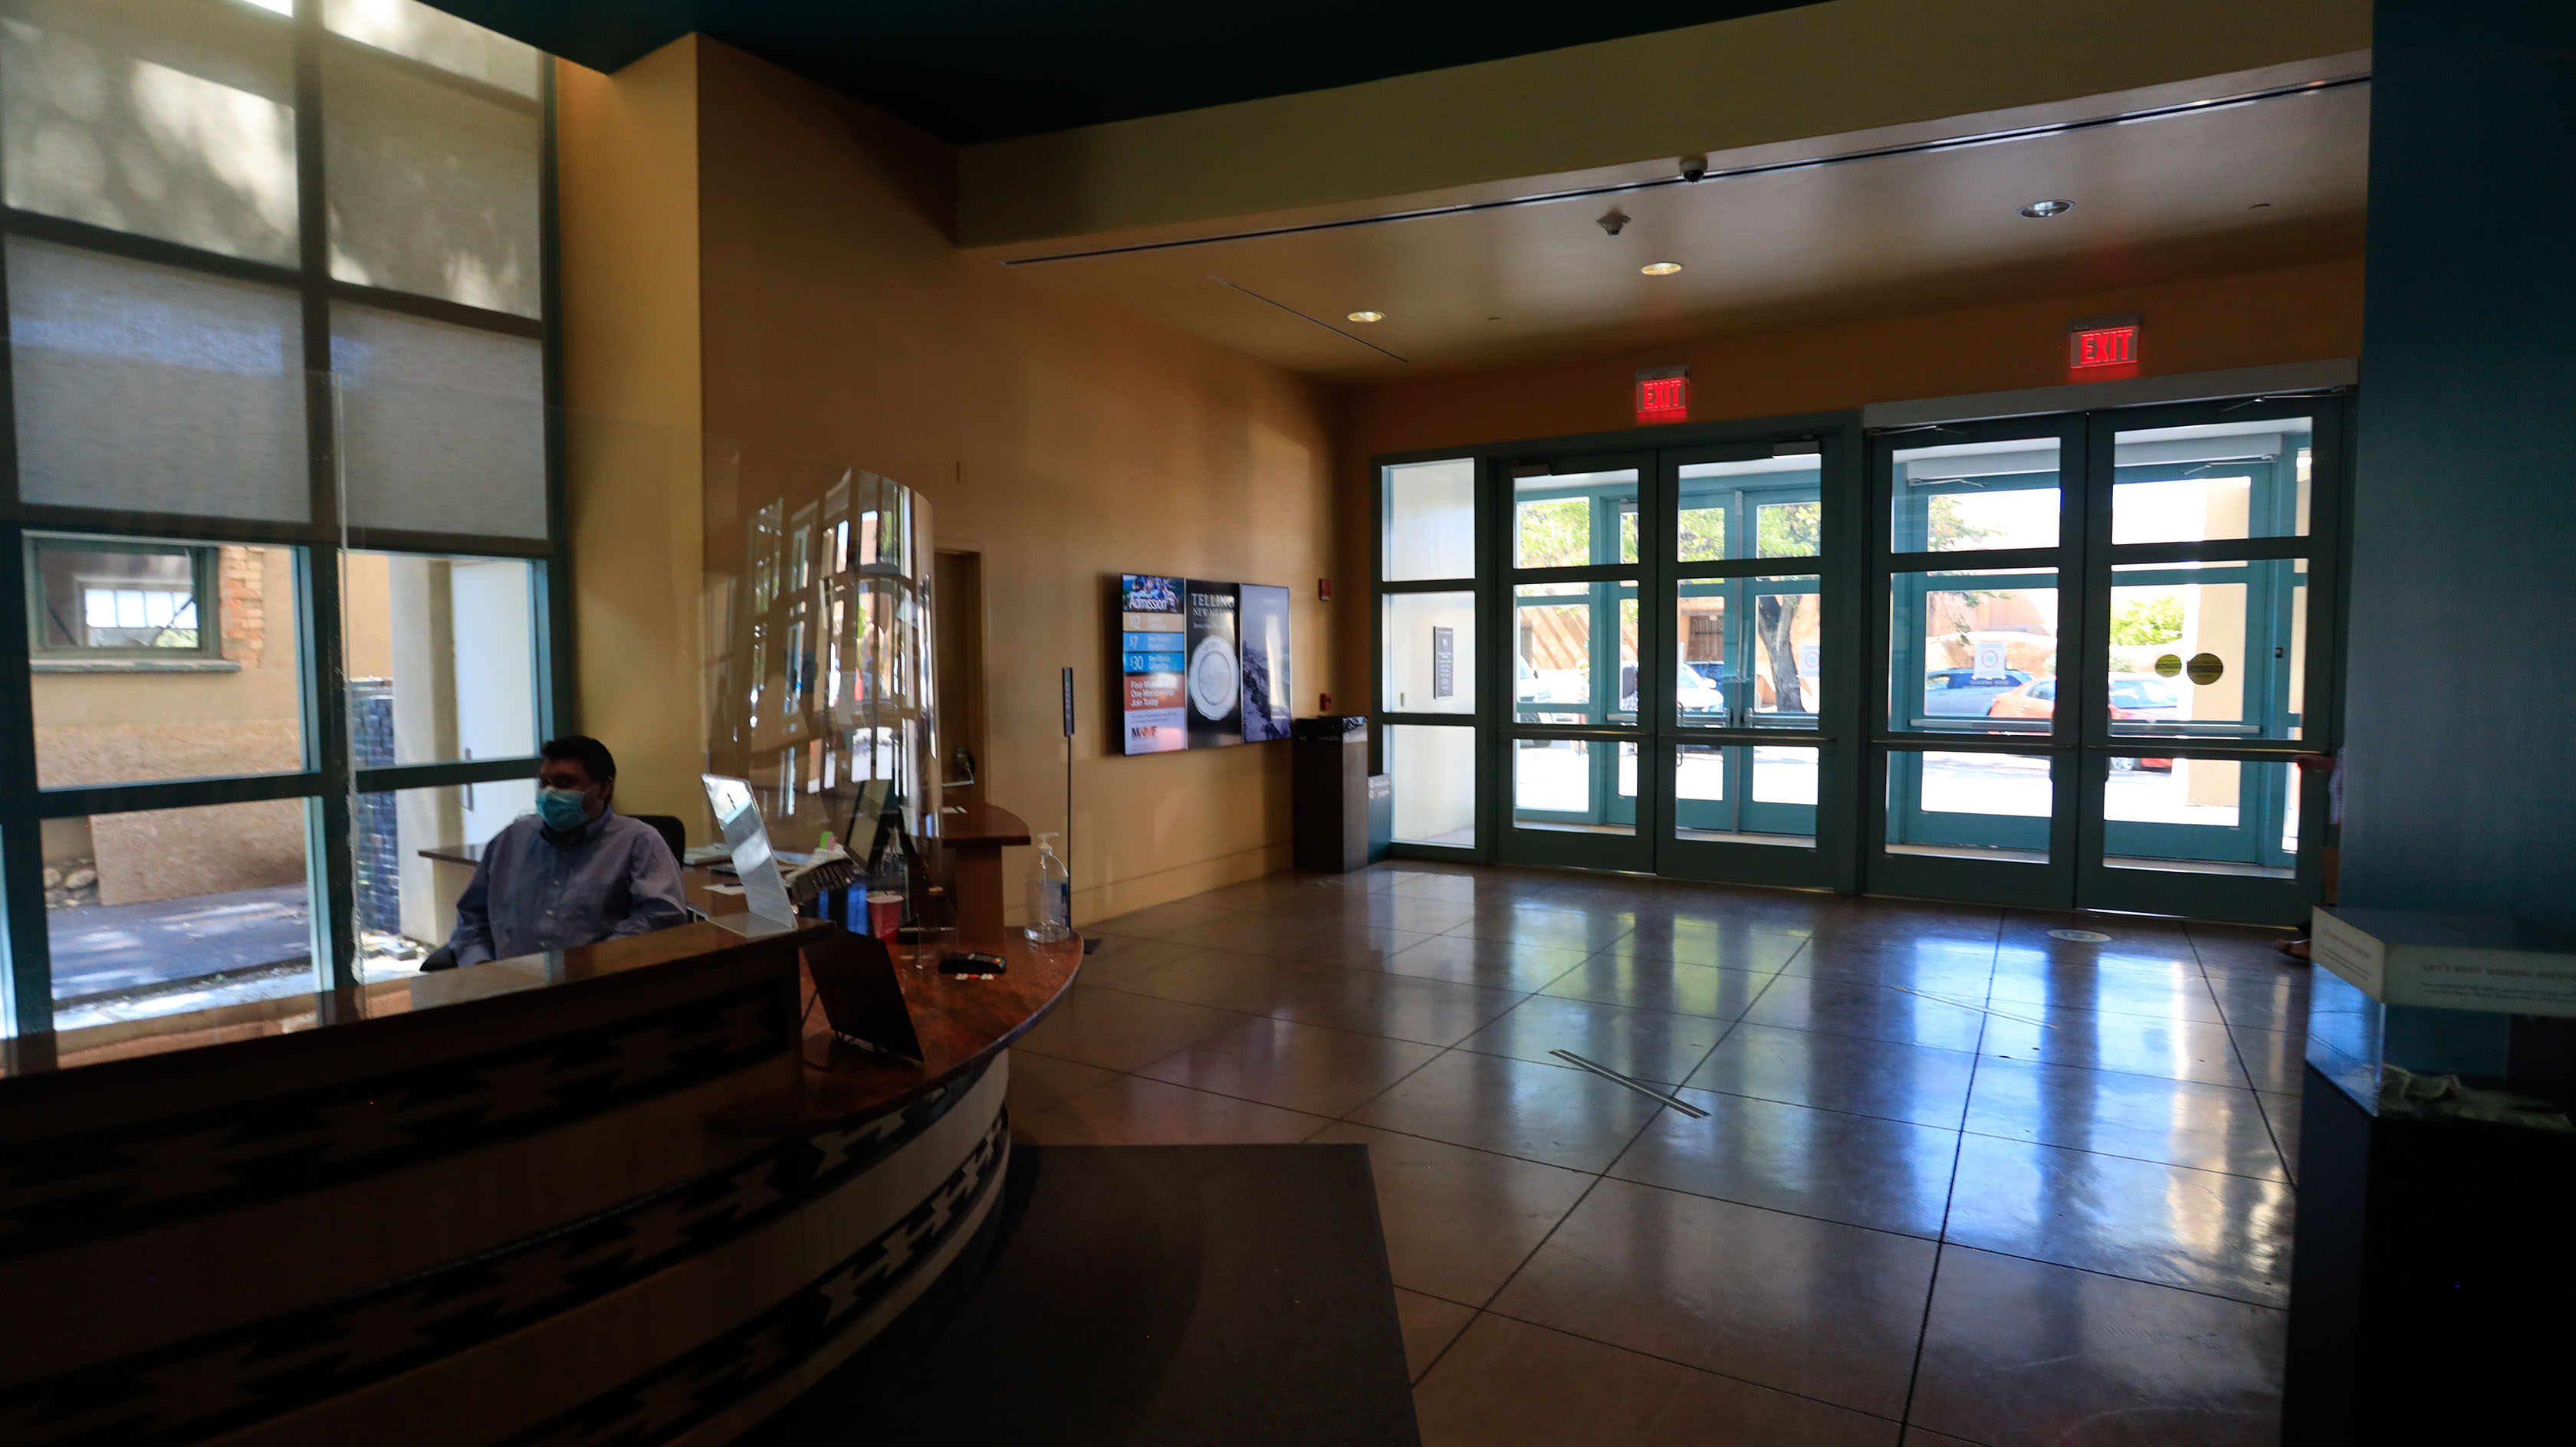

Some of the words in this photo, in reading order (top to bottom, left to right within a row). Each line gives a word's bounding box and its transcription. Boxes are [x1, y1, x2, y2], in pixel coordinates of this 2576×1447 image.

[2081, 329, 2133, 365] EXIT
[1644, 380, 1682, 409] EXIT
[1129, 595, 1168, 611] Admission
[1191, 593, 1235, 609] TELLING
[1209, 608, 1235, 618] MEXO
[1129, 655, 1144, 671] $30
[1130, 689, 1142, 698] One
[1130, 698, 1142, 707] Join
[1143, 698, 1159, 707] Today
